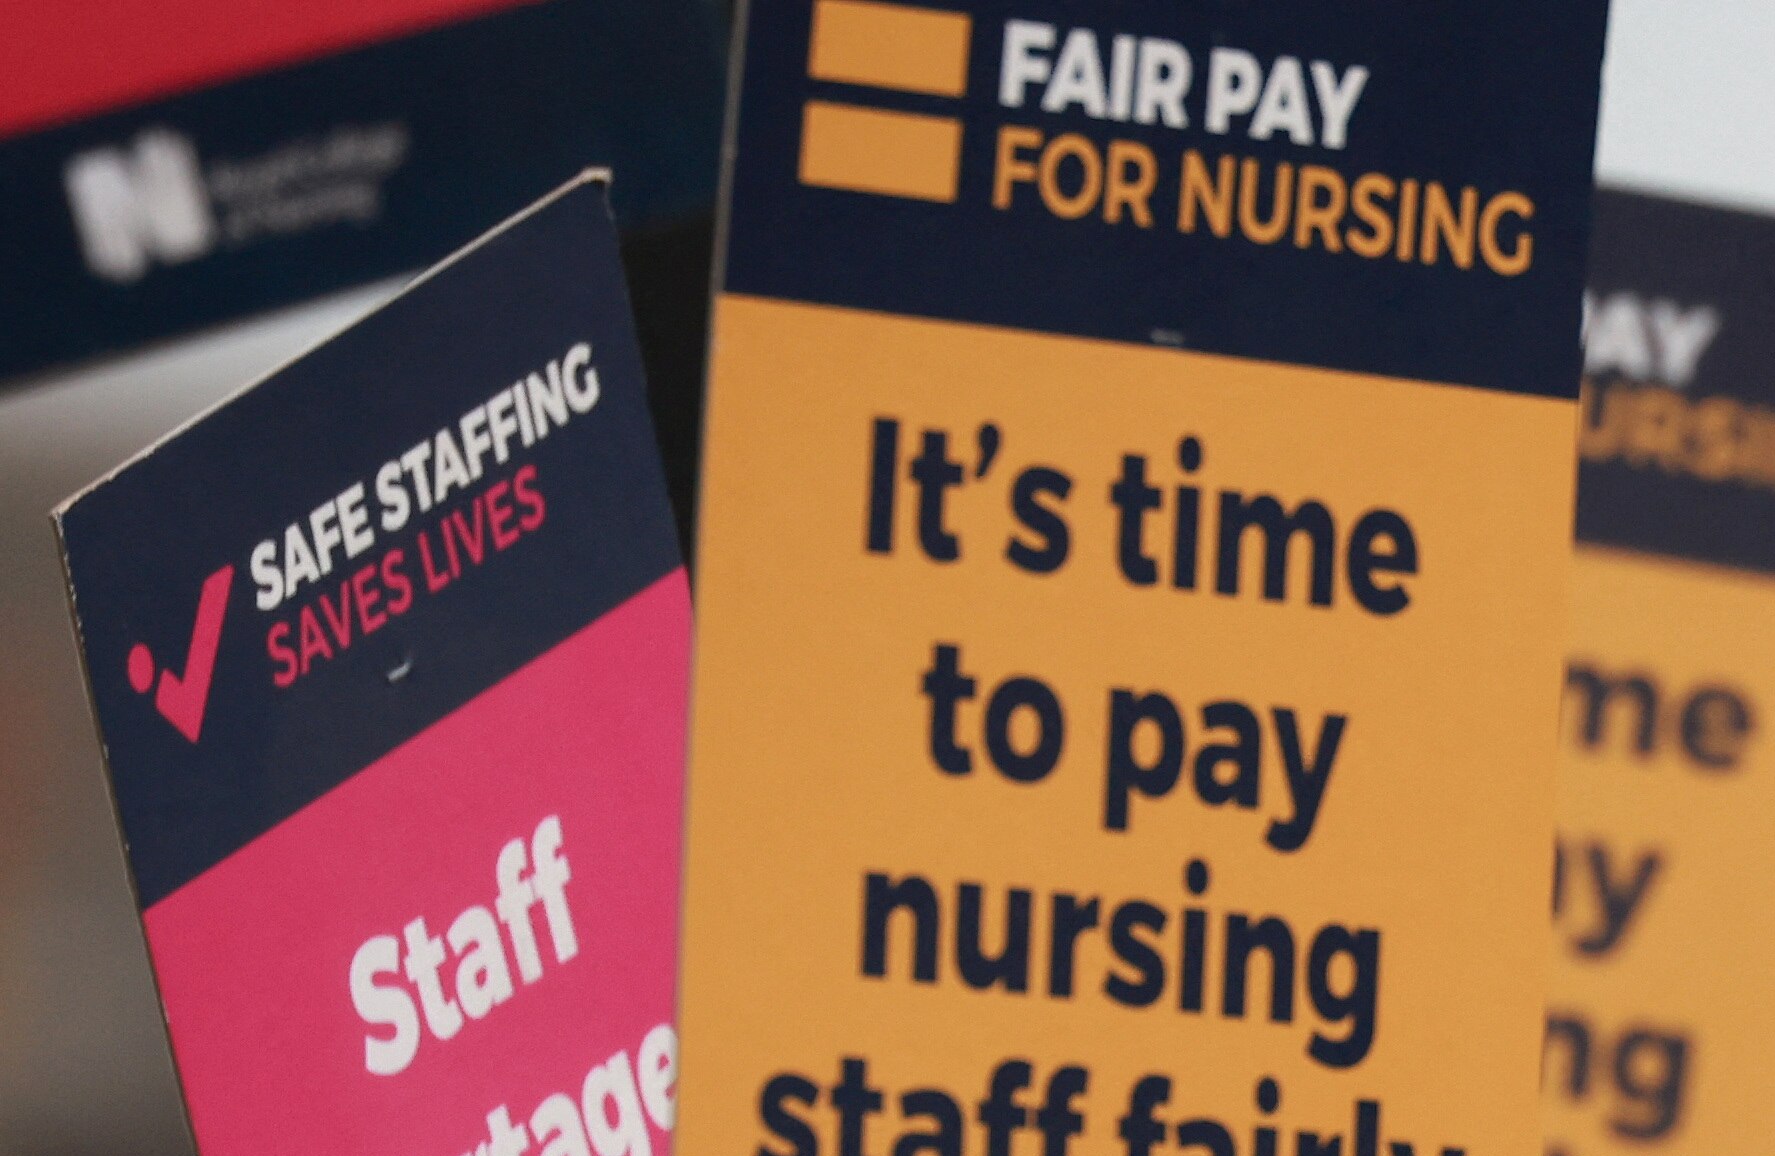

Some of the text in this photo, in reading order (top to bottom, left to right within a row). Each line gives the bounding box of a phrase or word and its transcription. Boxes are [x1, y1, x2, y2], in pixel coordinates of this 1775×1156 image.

[1000, 20, 1367, 149] FAIR PAY
[993, 125, 1535, 277] FOR NURSING
[251, 342, 600, 611] SAFE STAFFING
[267, 464, 546, 690] SAVES LIVES
[1110, 436, 1420, 619] time
[921, 643, 1348, 853] to pay
[349, 815, 578, 1076] Staff
[860, 858, 1382, 1069] nursing
